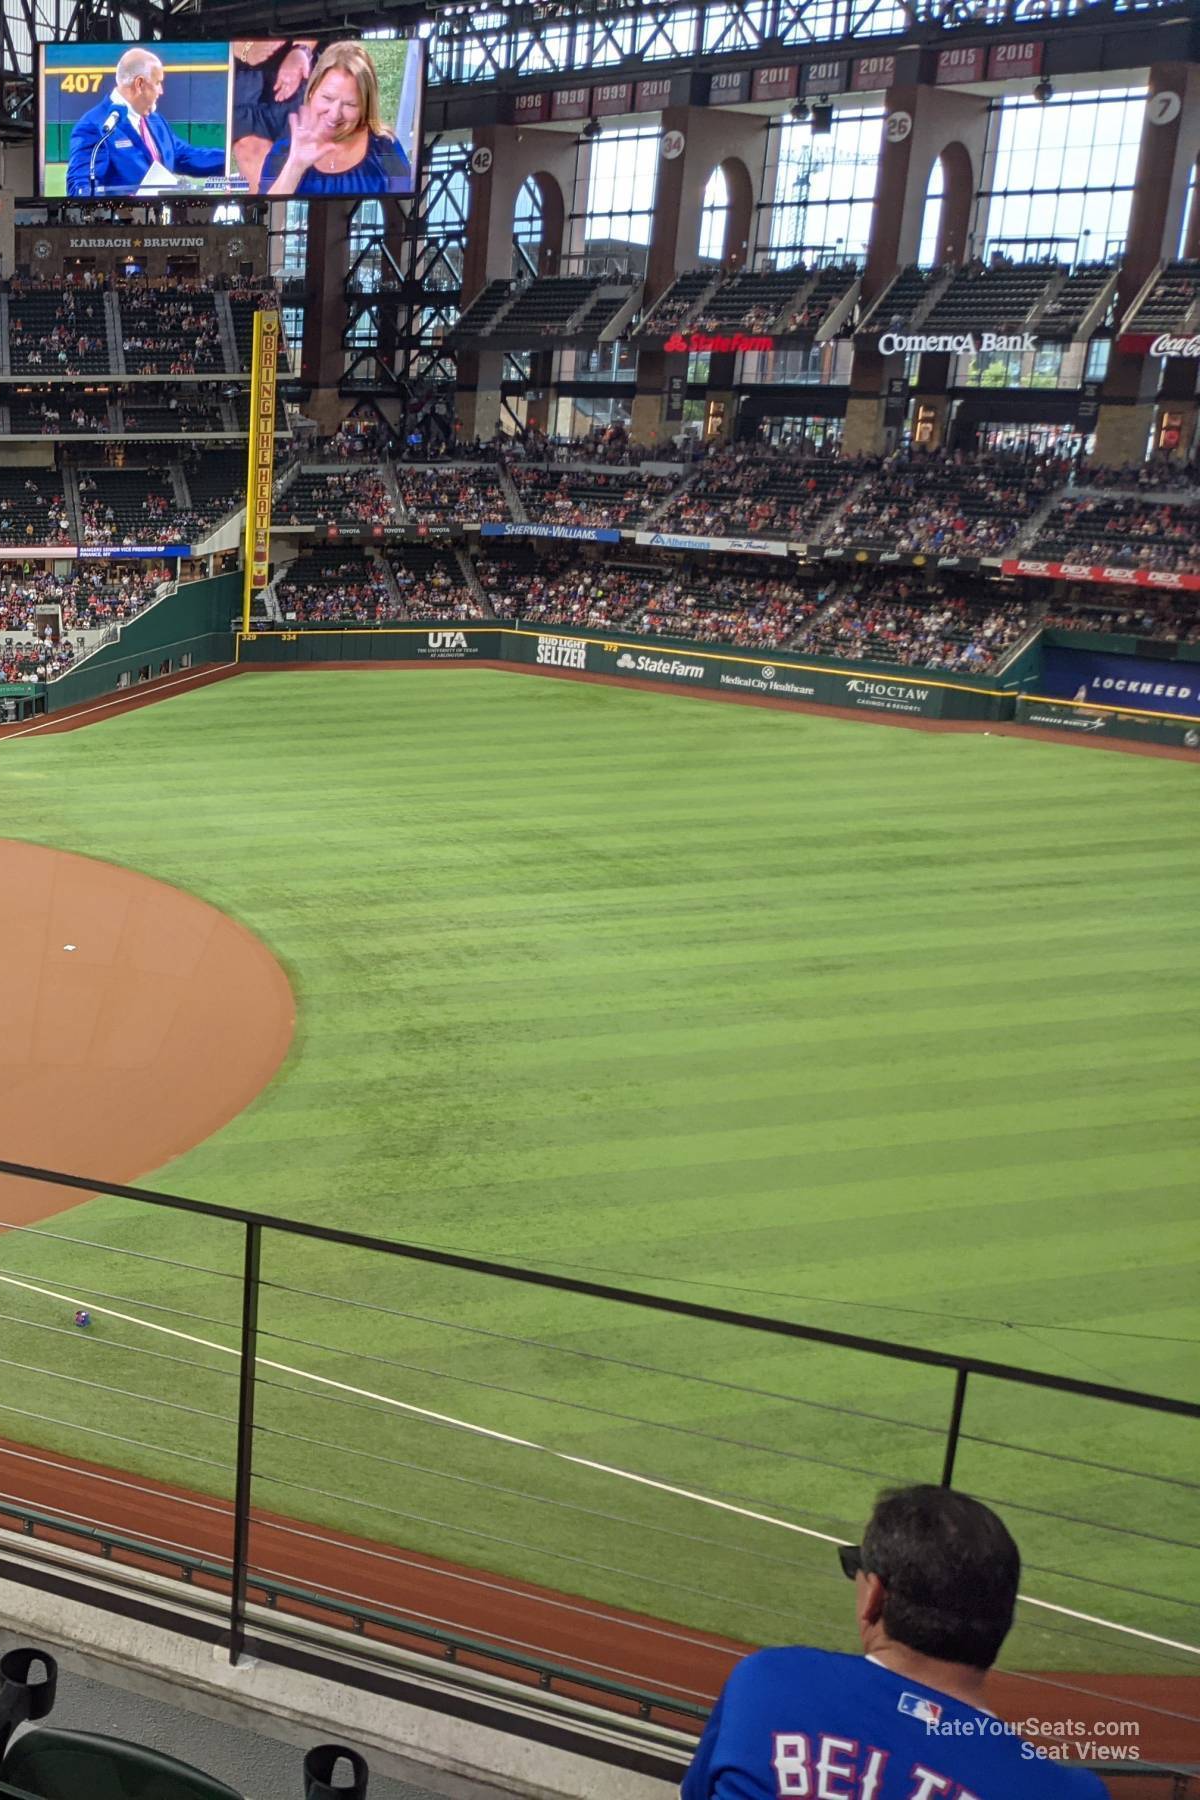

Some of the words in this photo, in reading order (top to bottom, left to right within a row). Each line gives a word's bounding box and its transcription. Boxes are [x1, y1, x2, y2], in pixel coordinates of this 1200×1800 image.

[939, 48, 977, 66] 2015
[996, 43, 1034, 61] 2016
[808, 61, 840, 80] 2011
[859, 56, 894, 74] 2012
[60, 73, 104, 94] 407
[710, 74, 742, 89] 2010
[759, 67, 790, 84] 2011
[597, 84, 627, 101] 1999
[641, 79, 672, 97] 2010
[1157, 100, 1172, 119] 7
[887, 119, 909, 135] 26
[663, 135, 683, 153] 34
[474, 152, 490, 168] 42
[70, 238, 132, 248] KARBACH
[142, 237, 204, 248] BREWING
[980, 331, 1039, 352] Bank
[260, 335, 275, 413] BRING
[259, 420, 271, 465] THE
[257, 470, 269, 528] HEAT
[338, 527, 361, 535] TOYOTA
[383, 527, 406, 535] TOYOTA
[1017, 561, 1049, 571] DEX
[1060, 564, 1092, 576] DEX
[1103, 568, 1136, 579] DEX
[1148, 571, 1181, 583] DEX
[428, 632, 468, 648] UTA
[538, 636, 558, 646] BUD
[558, 638, 587, 649] LIGHT
[536, 645, 586, 669] SELTZER
[720, 674, 750, 688] Medical
[751, 678, 768, 691] City
[769, 681, 815, 695] Healthcare
[852, 680, 929, 701] CHOCTAW
[1092, 676, 1192, 699] LOCKHEED
